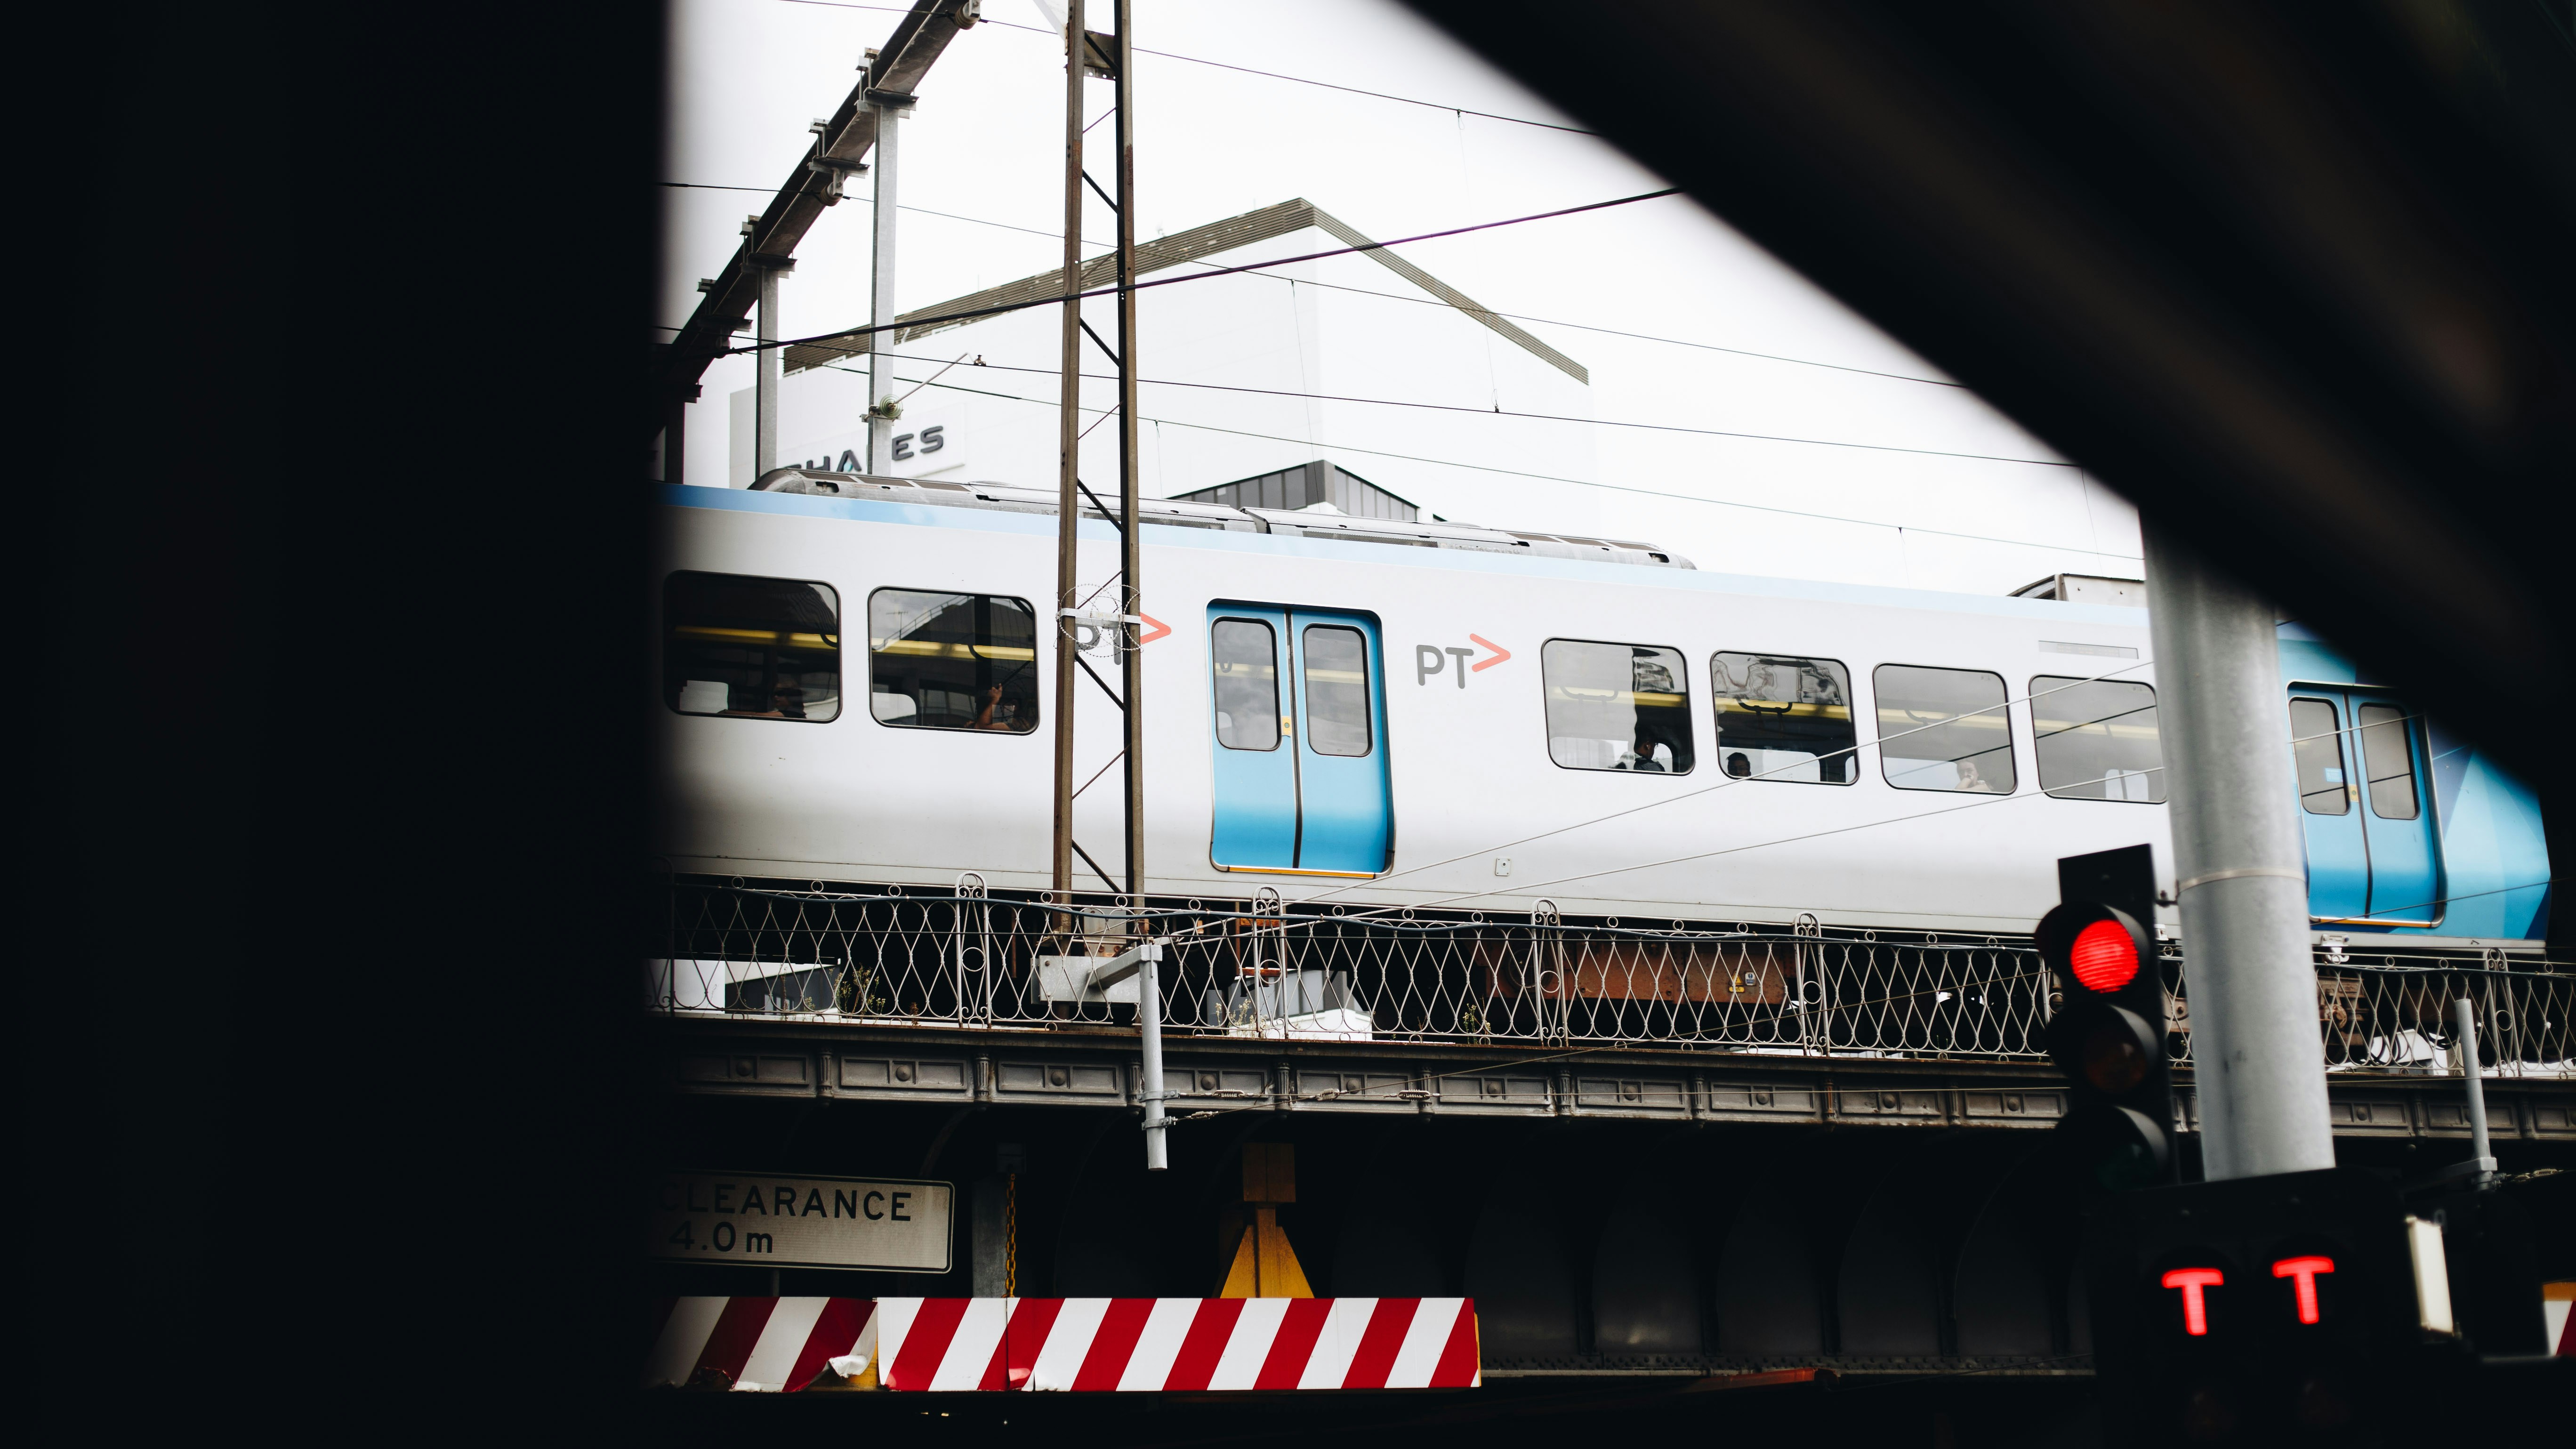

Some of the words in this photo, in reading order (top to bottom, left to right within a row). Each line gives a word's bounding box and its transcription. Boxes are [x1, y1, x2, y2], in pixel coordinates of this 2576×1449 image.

[783, 426, 944, 472] HAES
[2162, 1267, 2224, 1336] T
[2272, 1255, 2334, 1324] T
